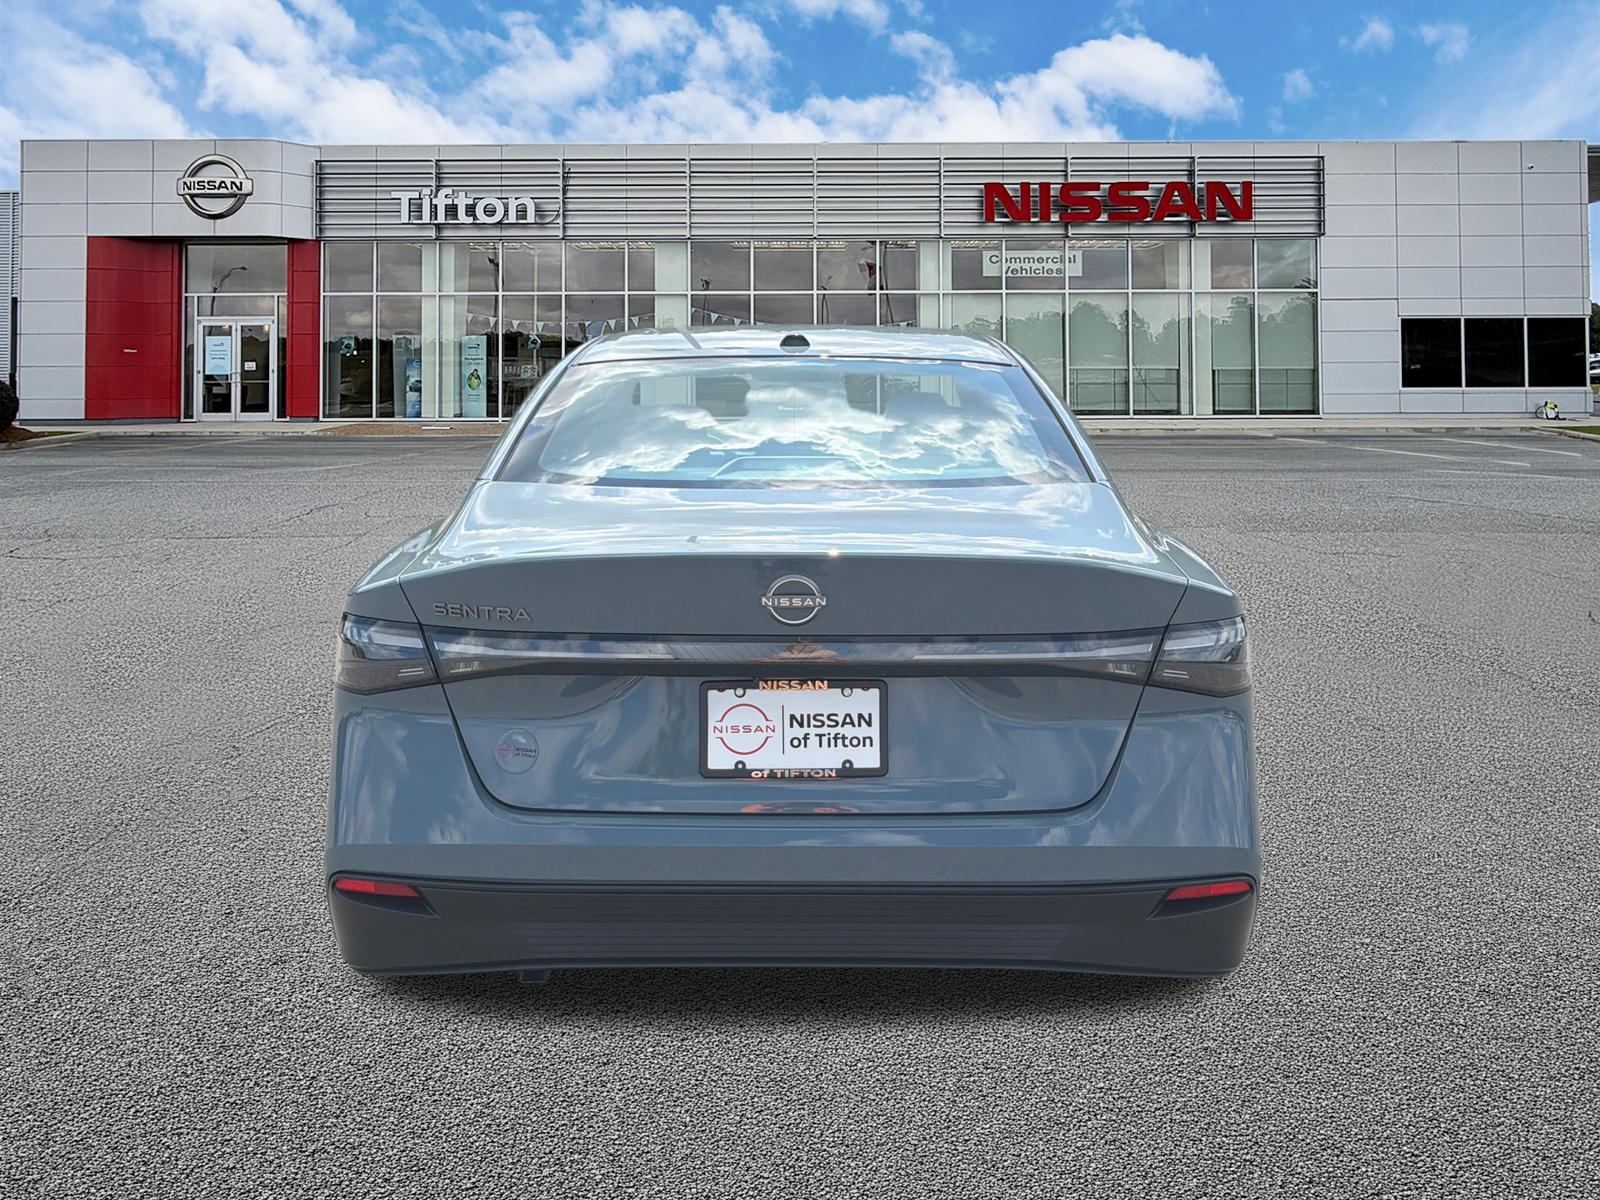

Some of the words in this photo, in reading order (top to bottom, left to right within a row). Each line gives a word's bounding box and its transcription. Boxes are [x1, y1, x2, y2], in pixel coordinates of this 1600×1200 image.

[183, 180, 243, 191] NISSAN
[391, 188, 536, 223] Tifton
[983, 181, 1253, 222] NISSAN
[761, 597, 827, 606] NISSAN
[432, 602, 533, 622] SENTRA
[758, 680, 829, 692] NISSAN
[789, 713, 873, 729] NISSAN
[713, 725, 776, 734] NISSAN
[789, 733, 811, 749] of
[815, 733, 874, 748] Tifton
[751, 769, 770, 778] of
[773, 769, 837, 778] TIFTON
